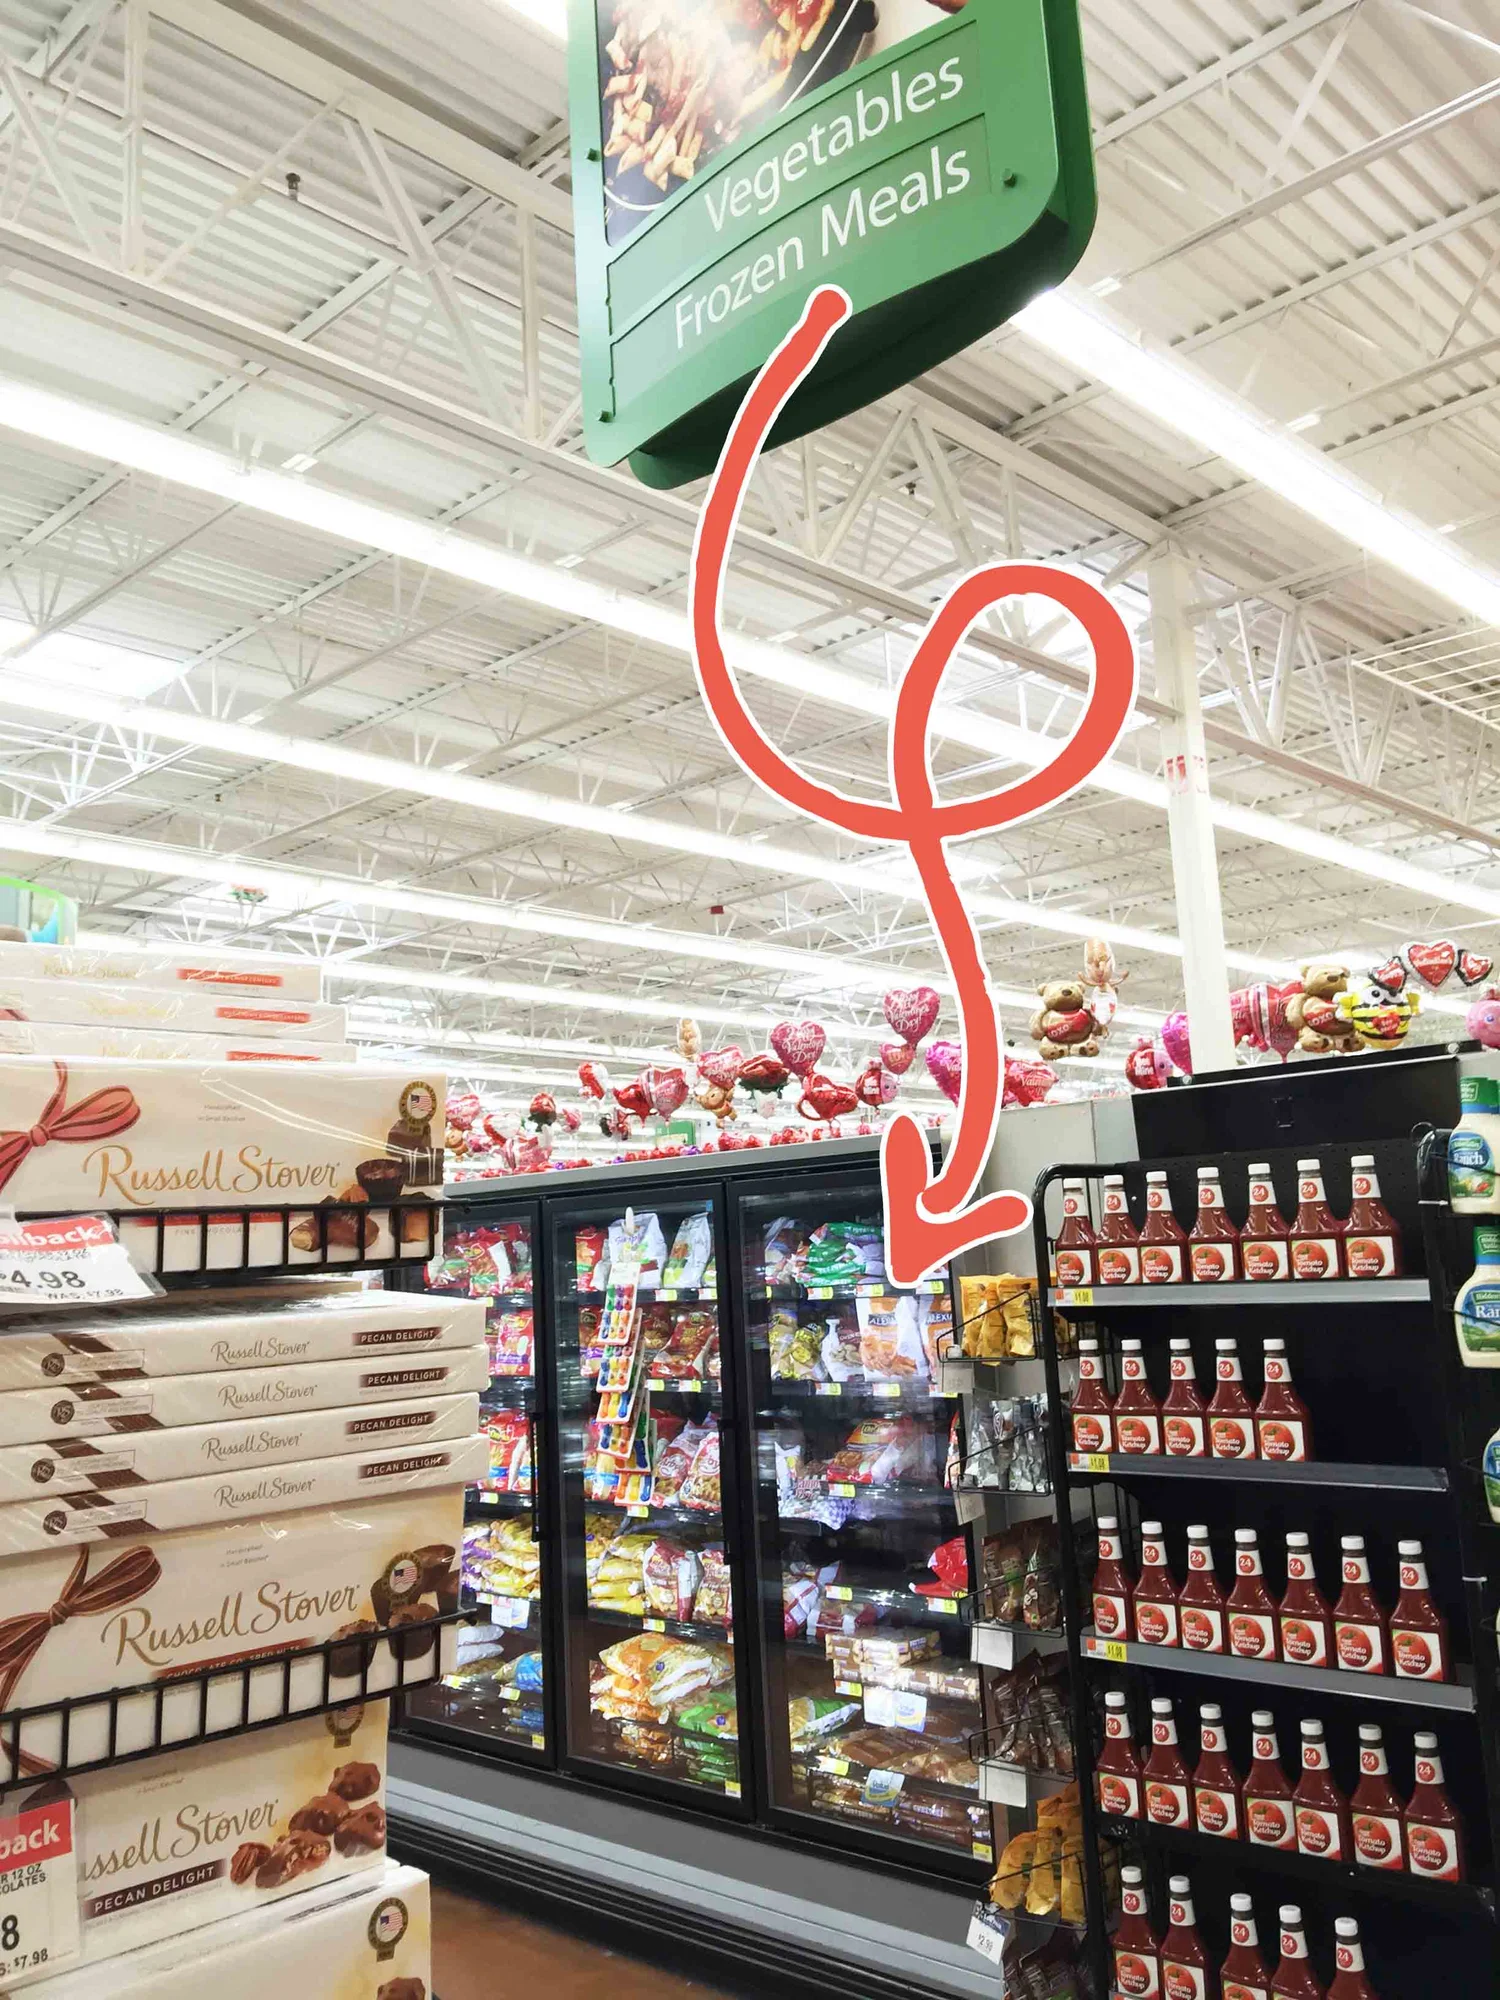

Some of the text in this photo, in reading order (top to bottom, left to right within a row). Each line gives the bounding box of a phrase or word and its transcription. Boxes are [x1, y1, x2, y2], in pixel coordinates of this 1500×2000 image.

[704, 57, 964, 233] Vegetables
[675, 145, 973, 350] Frozen Meals
[82, 1144, 339, 1206] Russell Stover
[1302, 1184, 1314, 1193] 24
[1355, 1181, 1367, 1189] 24
[1200, 1191, 1211, 1199] 24
[1253, 1188, 1265, 1196] 24
[1107, 1197, 1118, 1205] 24
[1148, 1194, 1159, 1203] 24
[361, 1330, 434, 1343] PECAN DELIGHT
[210, 1337, 307, 1364] Russell Stover
[1082, 1363, 1090, 1371] 24
[1126, 1363, 1136, 1371] 24
[1172, 1362, 1182, 1371] 24
[1220, 1364, 1230, 1372] 24
[1268, 1365, 1279, 1373] 24
[368, 1370, 440, 1384] PECAN DELIGHT
[218, 1381, 315, 1409] Russell Stover
[354, 1414, 429, 1431] PECAN DELIGHT
[201, 1431, 301, 1461] Russell Stover
[367, 1457, 442, 1475] PECAN DELIGHT
[213, 1477, 315, 1508] Russell Stover
[1145, 1548, 1156, 1557] 24
[1190, 1553, 1202, 1562] 24
[1239, 1558, 1251, 1567] 24
[1290, 1561, 1301, 1570] 24
[1345, 1565, 1356, 1574] 24
[1402, 1570, 1414, 1579] 24
[100, 1582, 359, 1667] Russell Stover
[1107, 1720, 1118, 1730] 24
[1154, 1726, 1165, 1736] 24
[1203, 1732, 1213, 1742] 24
[1257, 1741, 1270, 1750] 24
[1305, 1750, 1317, 1760] 24
[1362, 1755, 1374, 1764] 24
[1418, 1765, 1431, 1774] 24
[170, 1804, 277, 1858] Stover
[12, 1869, 23, 1881] 12
[27, 1863, 42, 1876] OZ
[95, 1888, 146, 1913] PECAN
[153, 1866, 214, 1895] DELIGHT
[1126, 1896, 1136, 1905] 24
[1172, 1906, 1182, 1916] 24
[1235, 1926, 1245, 1936] 24
[1283, 1938, 1293, 1948] 24
[14, 1948, 48, 1970] $7.98
[1338, 1950, 1349, 1961] 24
